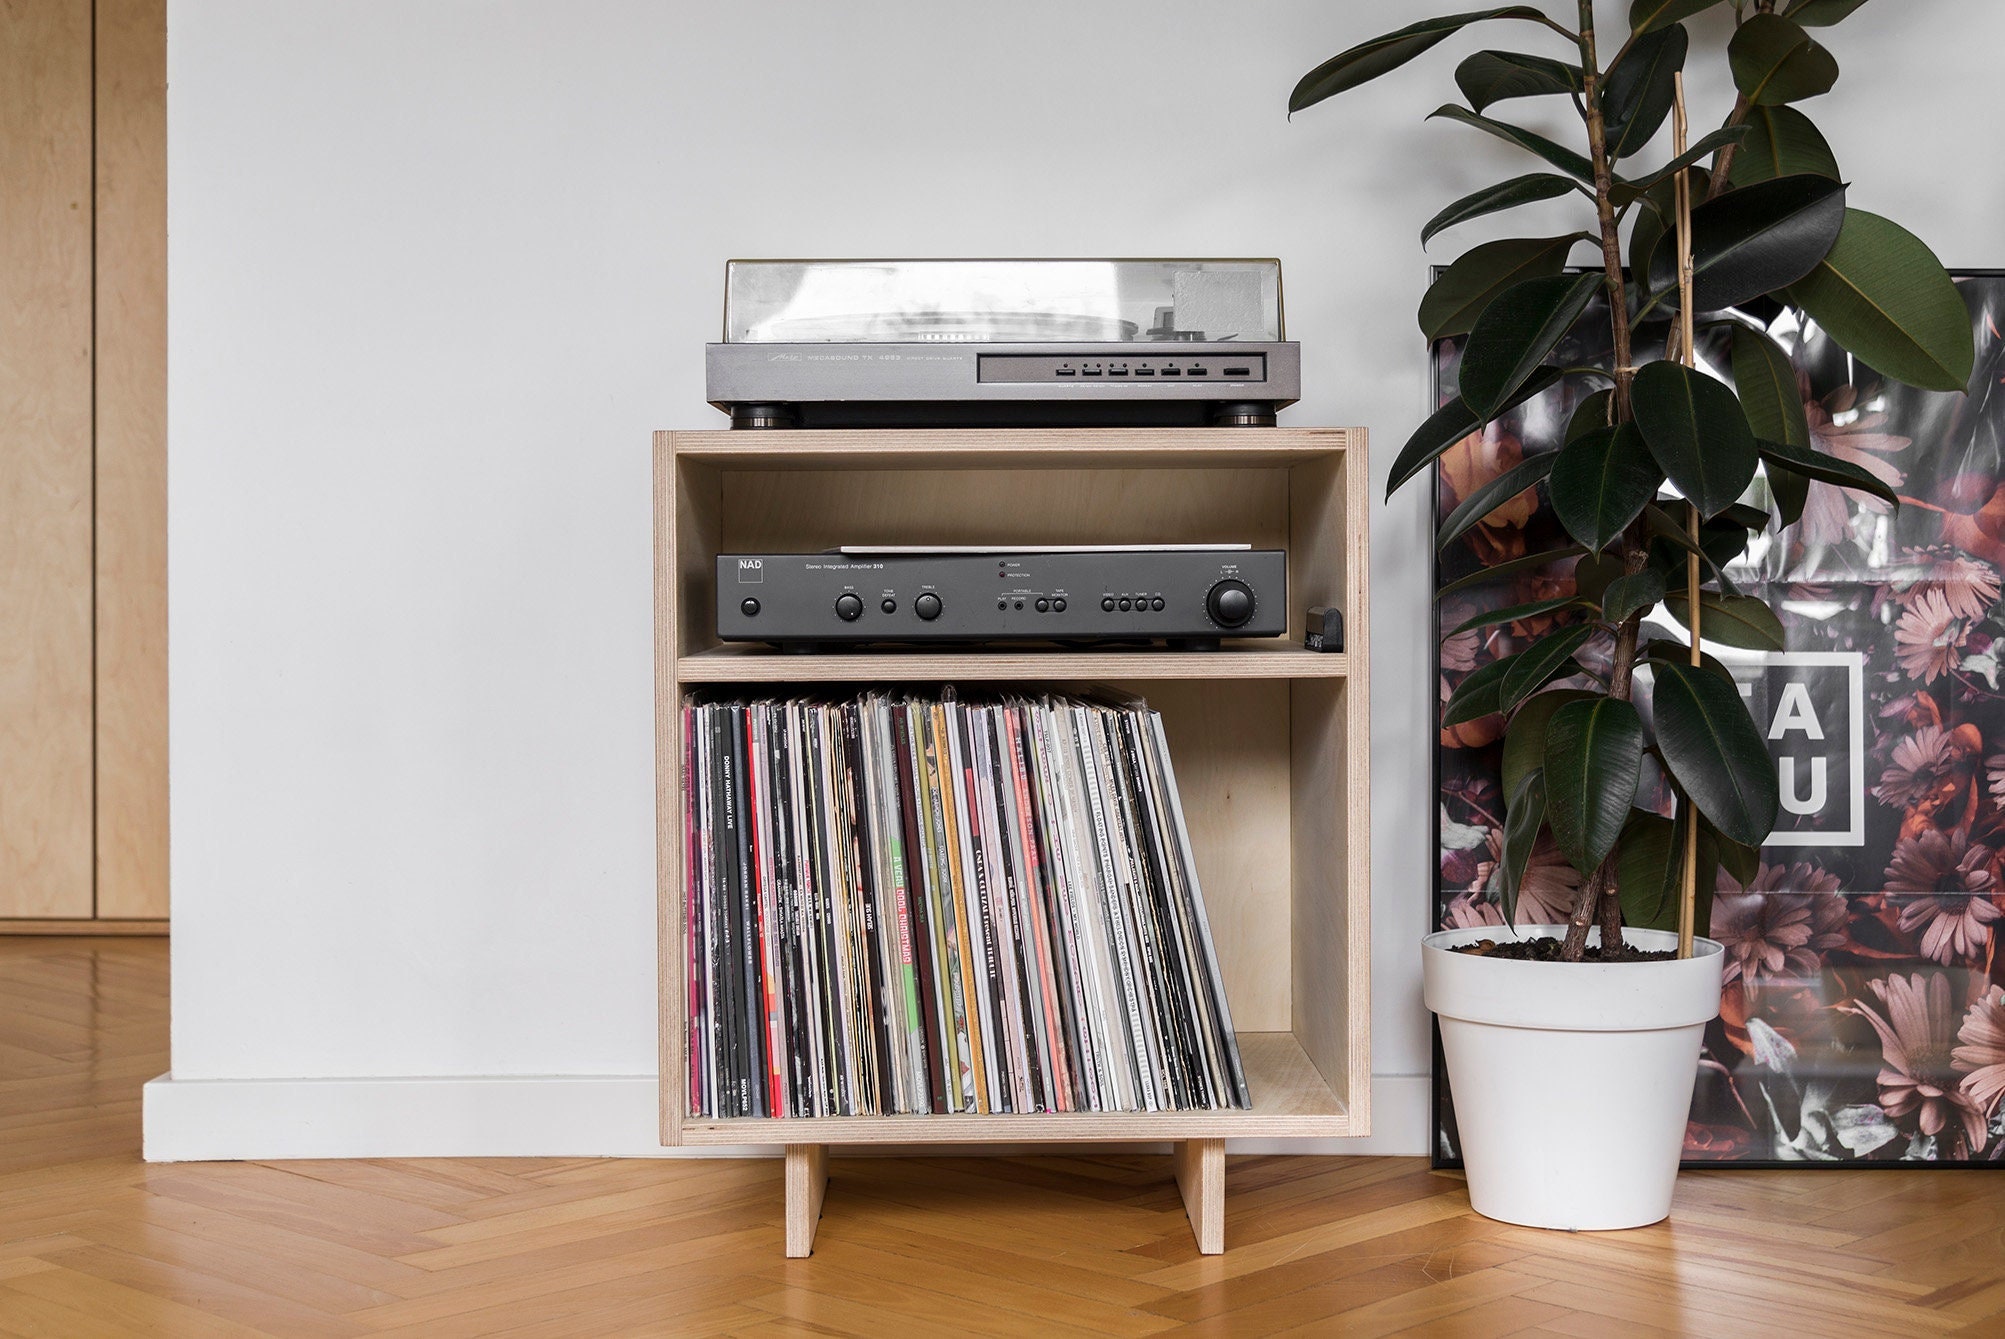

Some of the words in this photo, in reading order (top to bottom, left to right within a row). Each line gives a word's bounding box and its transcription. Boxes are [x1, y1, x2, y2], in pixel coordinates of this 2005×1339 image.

[740, 560, 762, 569] NAD
[823, 563, 849, 571] Integrated
[850, 563, 872, 571] Amplifier
[723, 755, 731, 778] DONNY
[724, 779, 732, 813] HATHAWAY
[725, 815, 733, 829] LIVE
[1095, 811, 1105, 837] FLOATING
[1099, 837, 1108, 857] POINTS
[893, 864, 904, 887] VERY
[1103, 858, 1113, 884] PHAROAH
[1107, 884, 1118, 910] SANDERS
[1115, 926, 1125, 949] LONDON
[1120, 950, 1130, 980] SYMPHONY
[1126, 980, 1137, 1012] ORCHESTRA
